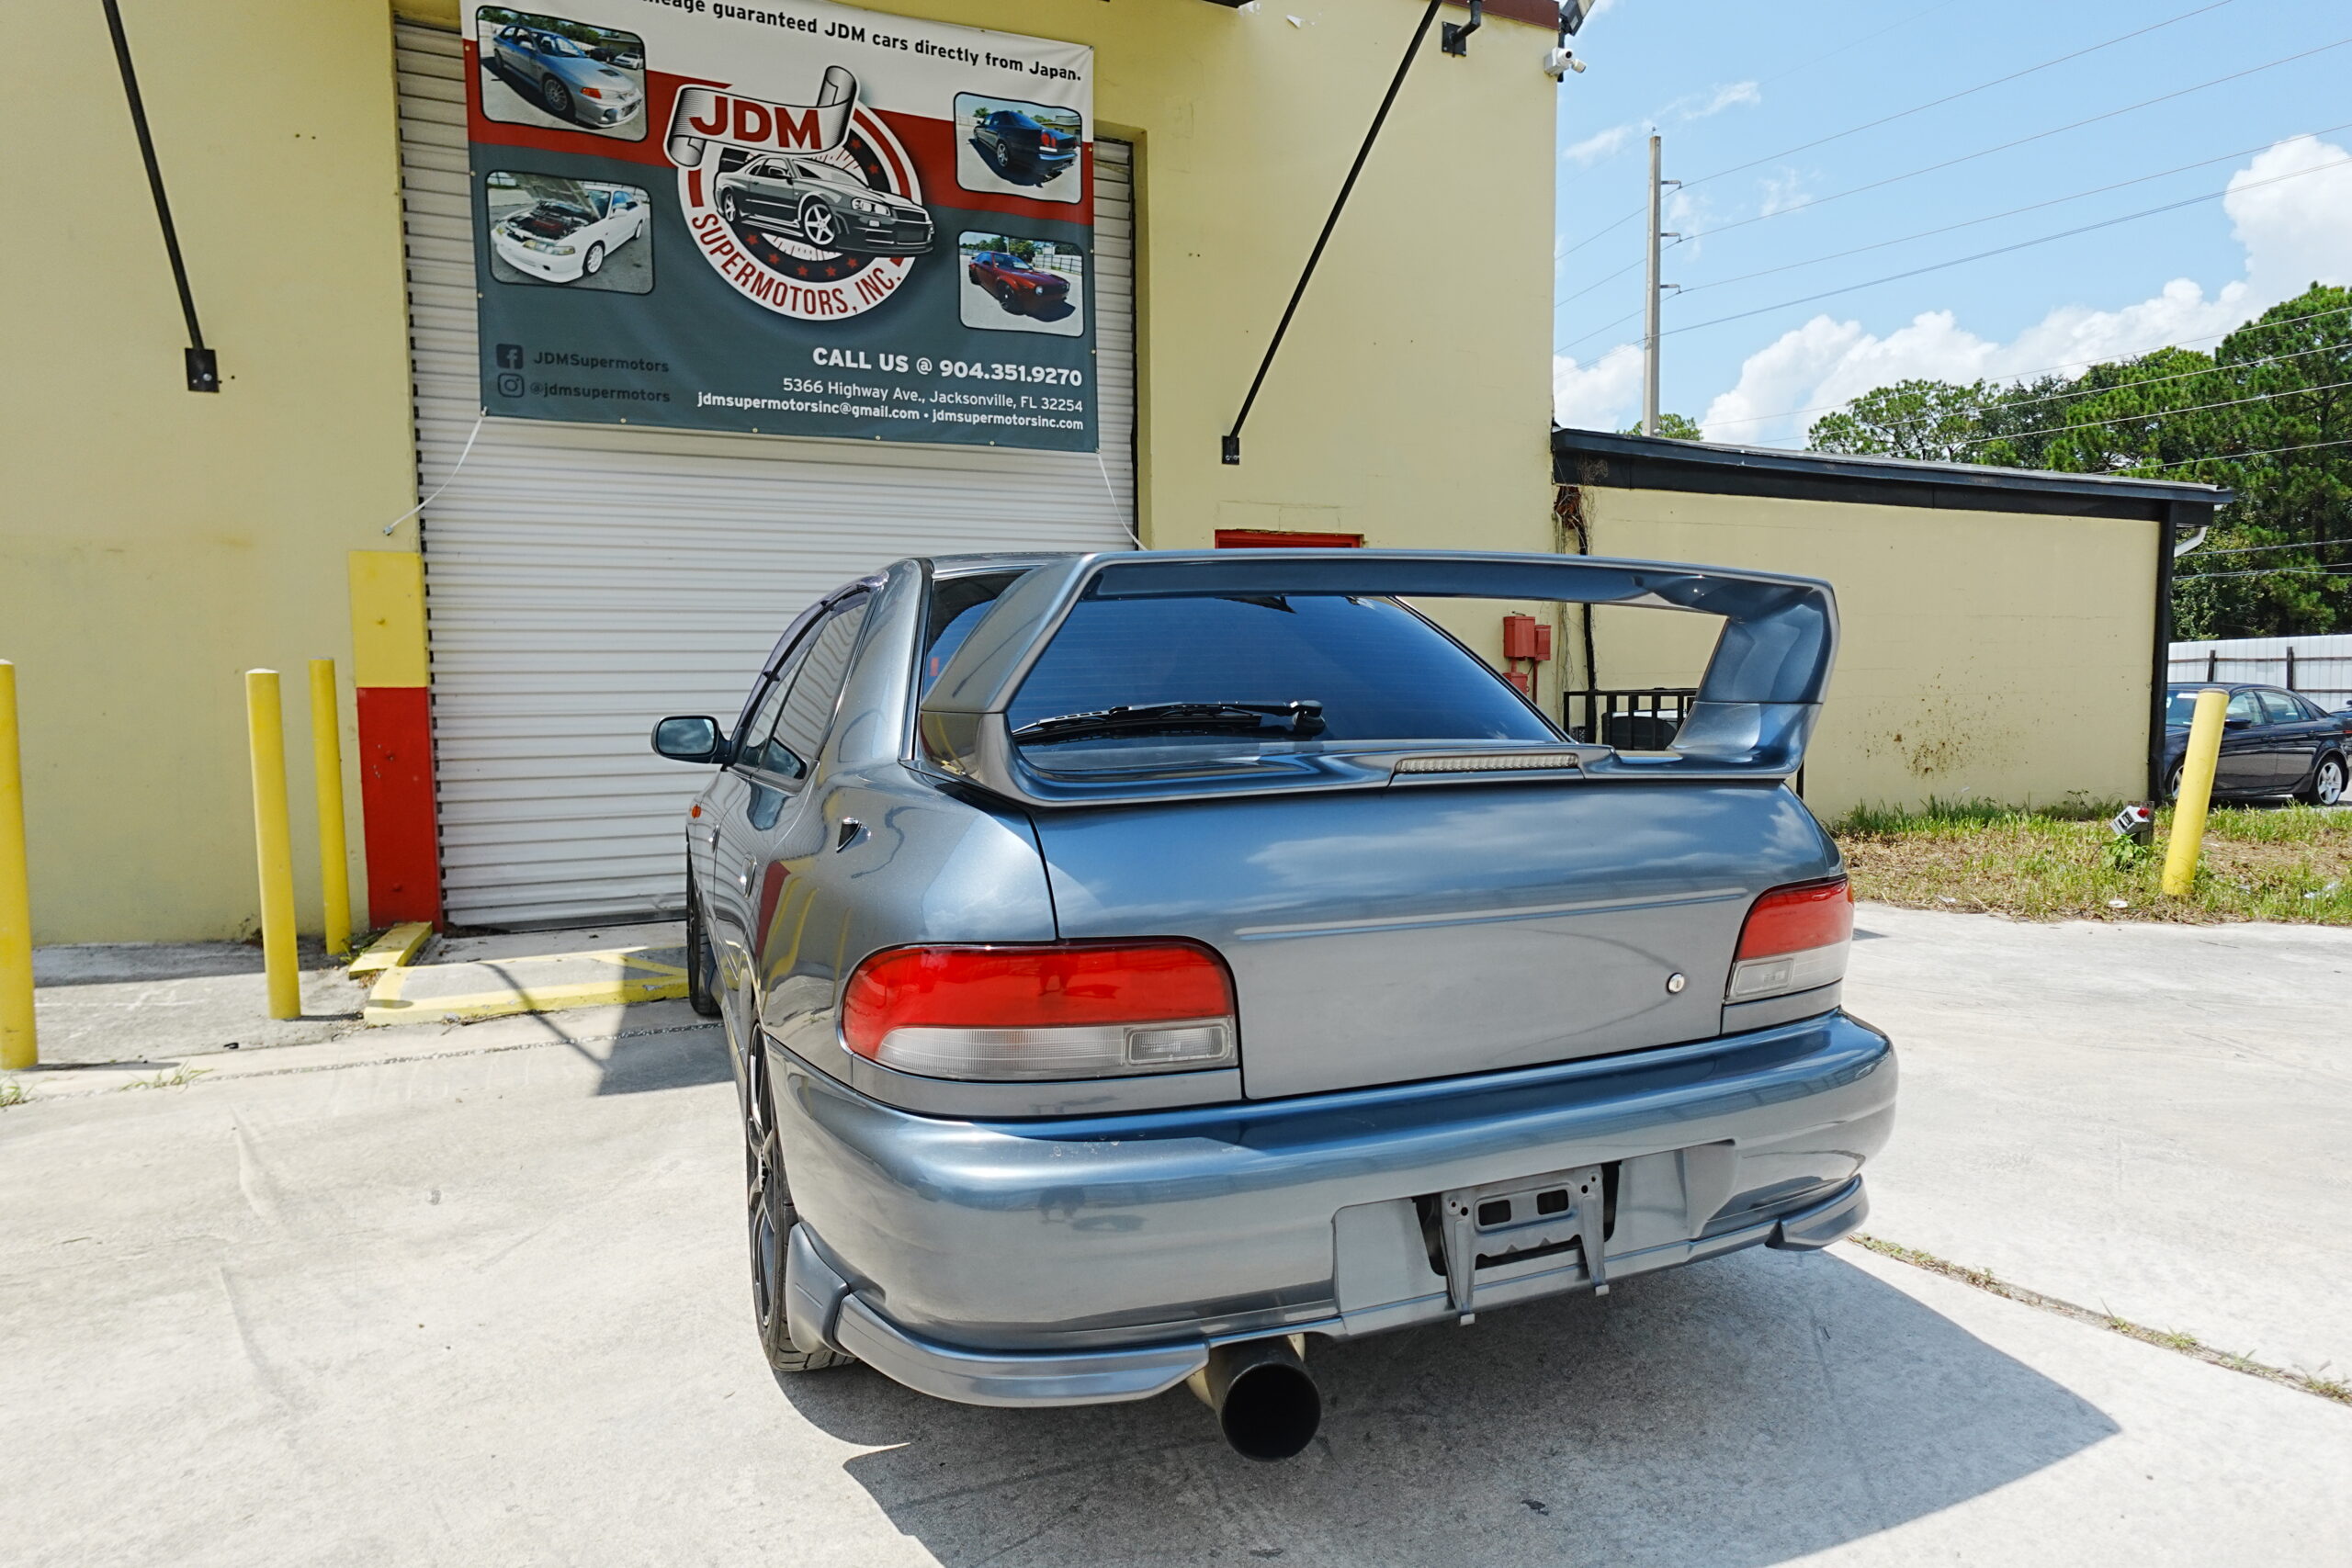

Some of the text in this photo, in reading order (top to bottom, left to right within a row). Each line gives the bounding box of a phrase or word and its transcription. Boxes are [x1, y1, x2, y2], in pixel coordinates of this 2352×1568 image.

[713, 3, 818, 33] guaranteed
[824, 21, 865, 42] JDM
[872, 32, 909, 51] cars
[915, 39, 979, 65] directly
[985, 52, 1023, 71] from
[1029, 61, 1081, 81] Japan.
[689, 95, 822, 150] JDM
[691, 213, 902, 314] SUPERMOTORS, INC.
[533, 352, 670, 372] JDMSupermotors
[812, 346, 1083, 386] CALL US @ 904.351.9270
[529, 381, 671, 402] @jdmsupermotors
[696, 391, 1084, 430] jdmsupermotorsinc@gmail.com jdmsupermotorsinc.com
[783, 378, 1083, 412] 5366 Highway Ave., Jacksonville, FL 32254
